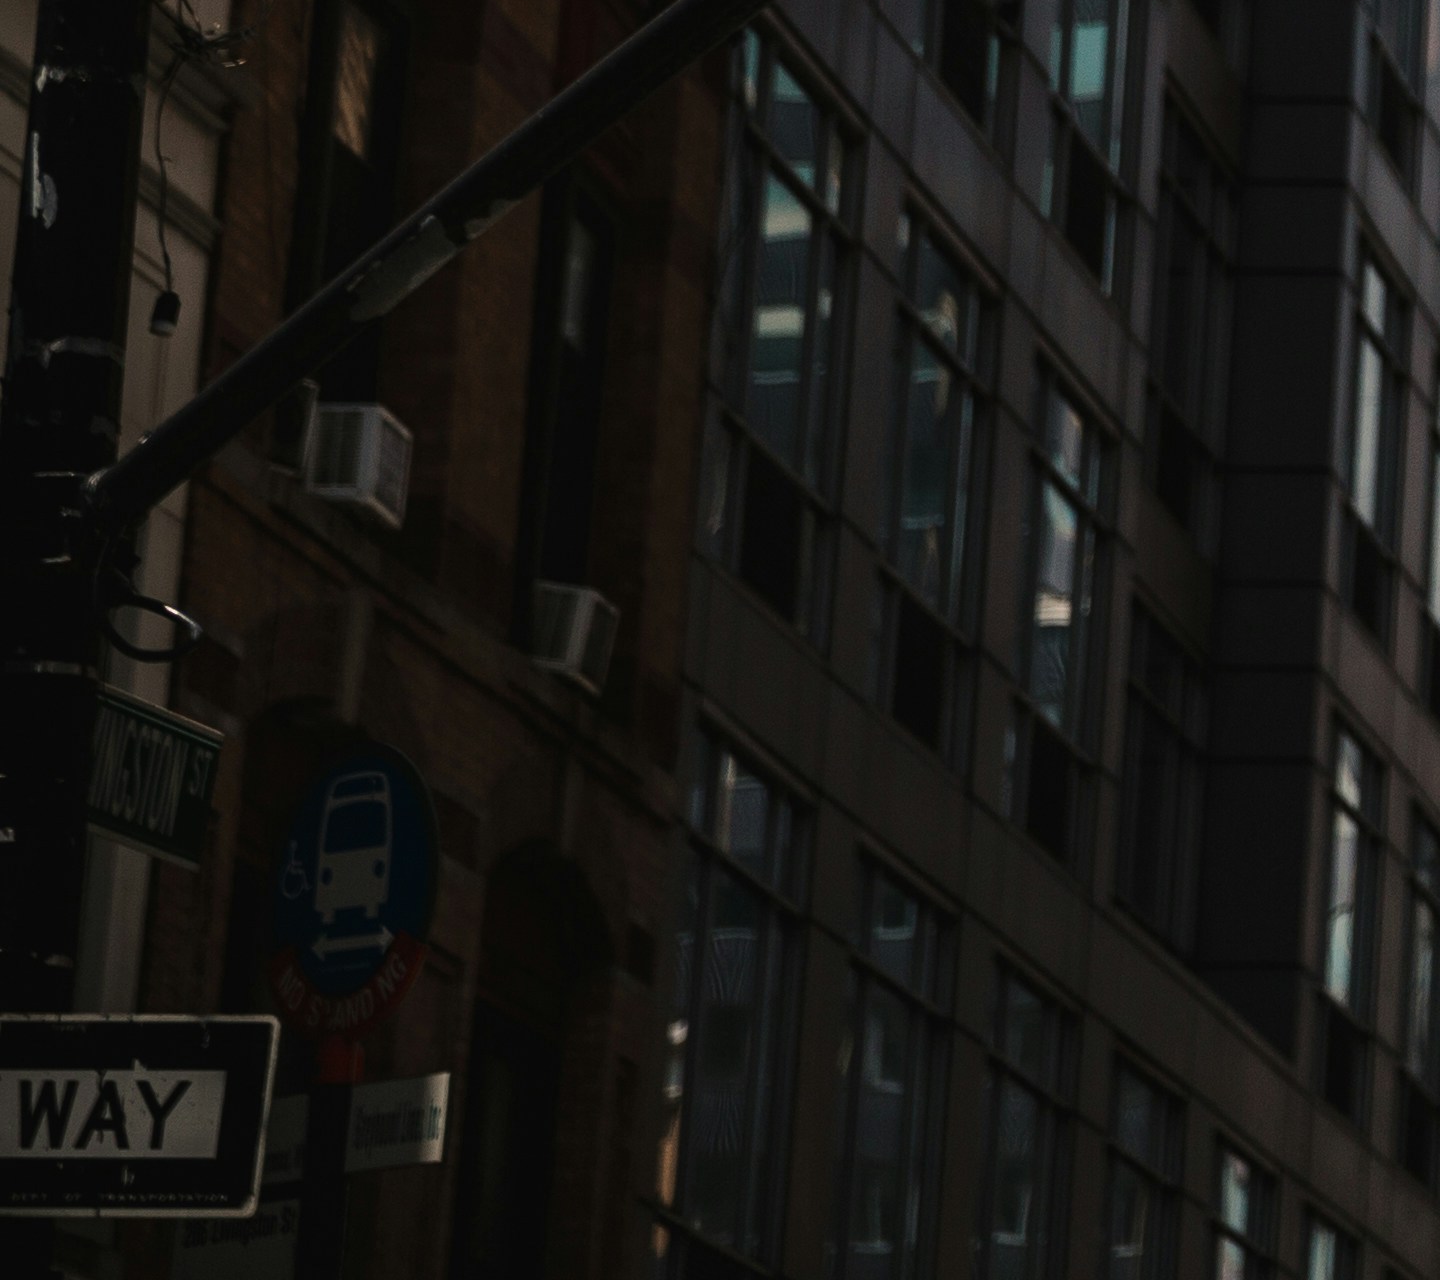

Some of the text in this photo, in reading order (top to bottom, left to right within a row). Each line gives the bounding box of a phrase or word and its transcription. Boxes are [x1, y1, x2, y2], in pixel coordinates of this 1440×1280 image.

[187, 746, 215, 801] ST
[279, 963, 306, 1012] NO
[20, 1079, 193, 1151] WAY
[99, 1191, 230, 1203] TRANSPORTATION
